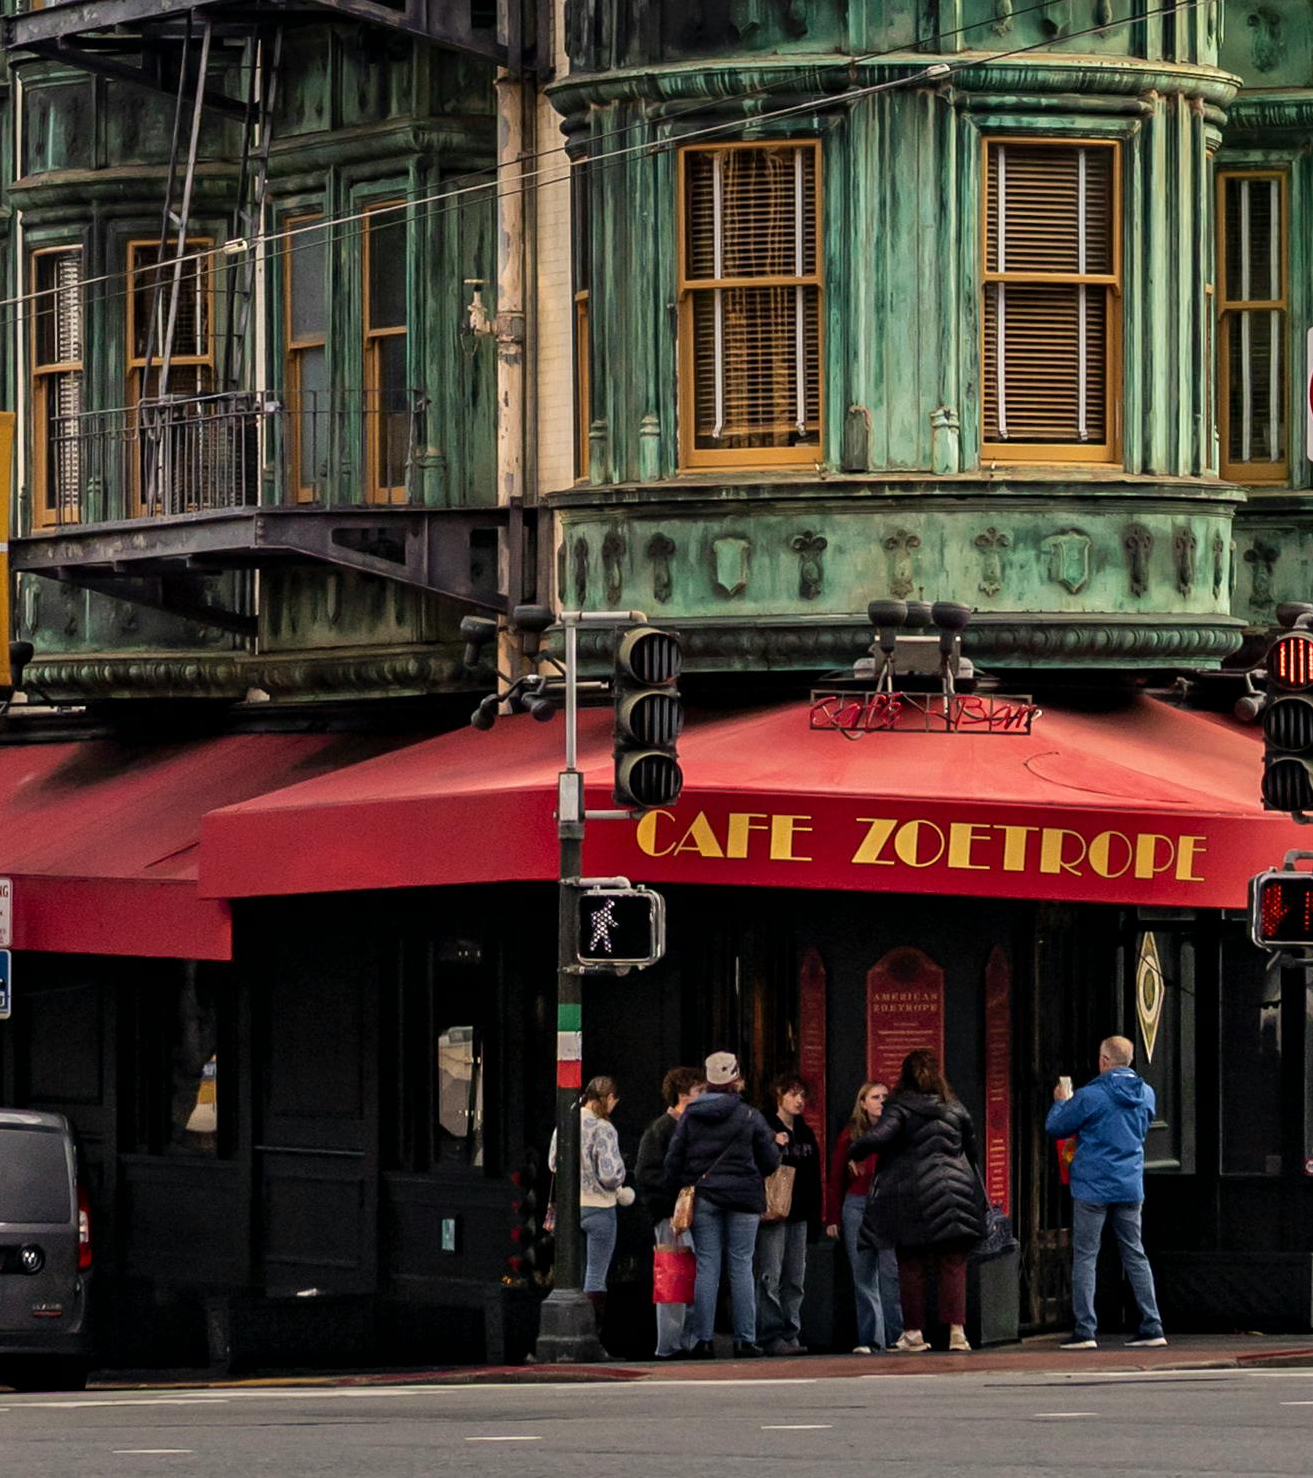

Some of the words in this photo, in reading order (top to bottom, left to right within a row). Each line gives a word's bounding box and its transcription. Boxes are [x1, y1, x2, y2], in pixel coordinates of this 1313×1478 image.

[636, 808, 813, 863] CAFE
[851, 817, 1208, 883] ZOETROPE
[873, 992, 938, 1001] AMERICAN
[873, 1004, 937, 1012] ZOETROPE
